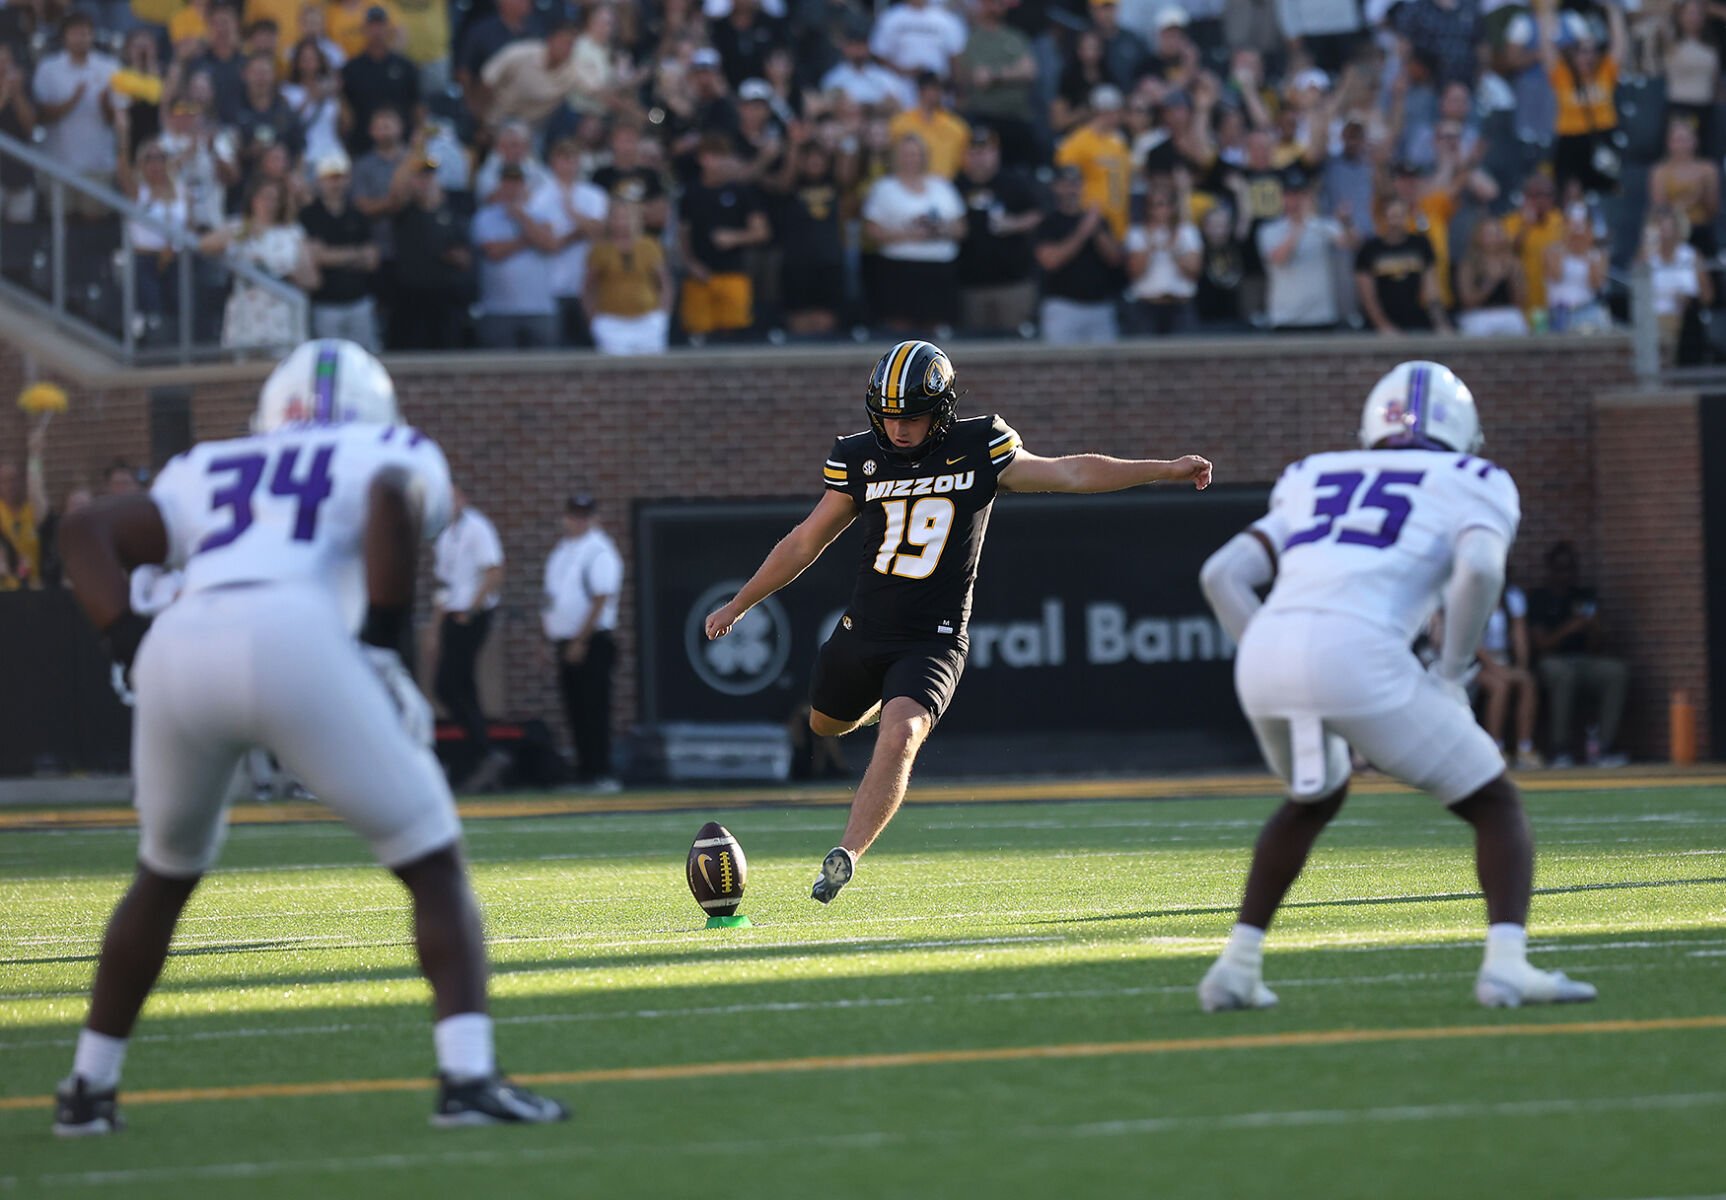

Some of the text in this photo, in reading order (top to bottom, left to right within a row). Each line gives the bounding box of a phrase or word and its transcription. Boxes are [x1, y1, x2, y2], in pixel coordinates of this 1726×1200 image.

[200, 444, 338, 553] 34
[865, 470, 975, 502] MIZZOU
[1283, 469, 1427, 549] 35
[873, 497, 956, 580] 19
